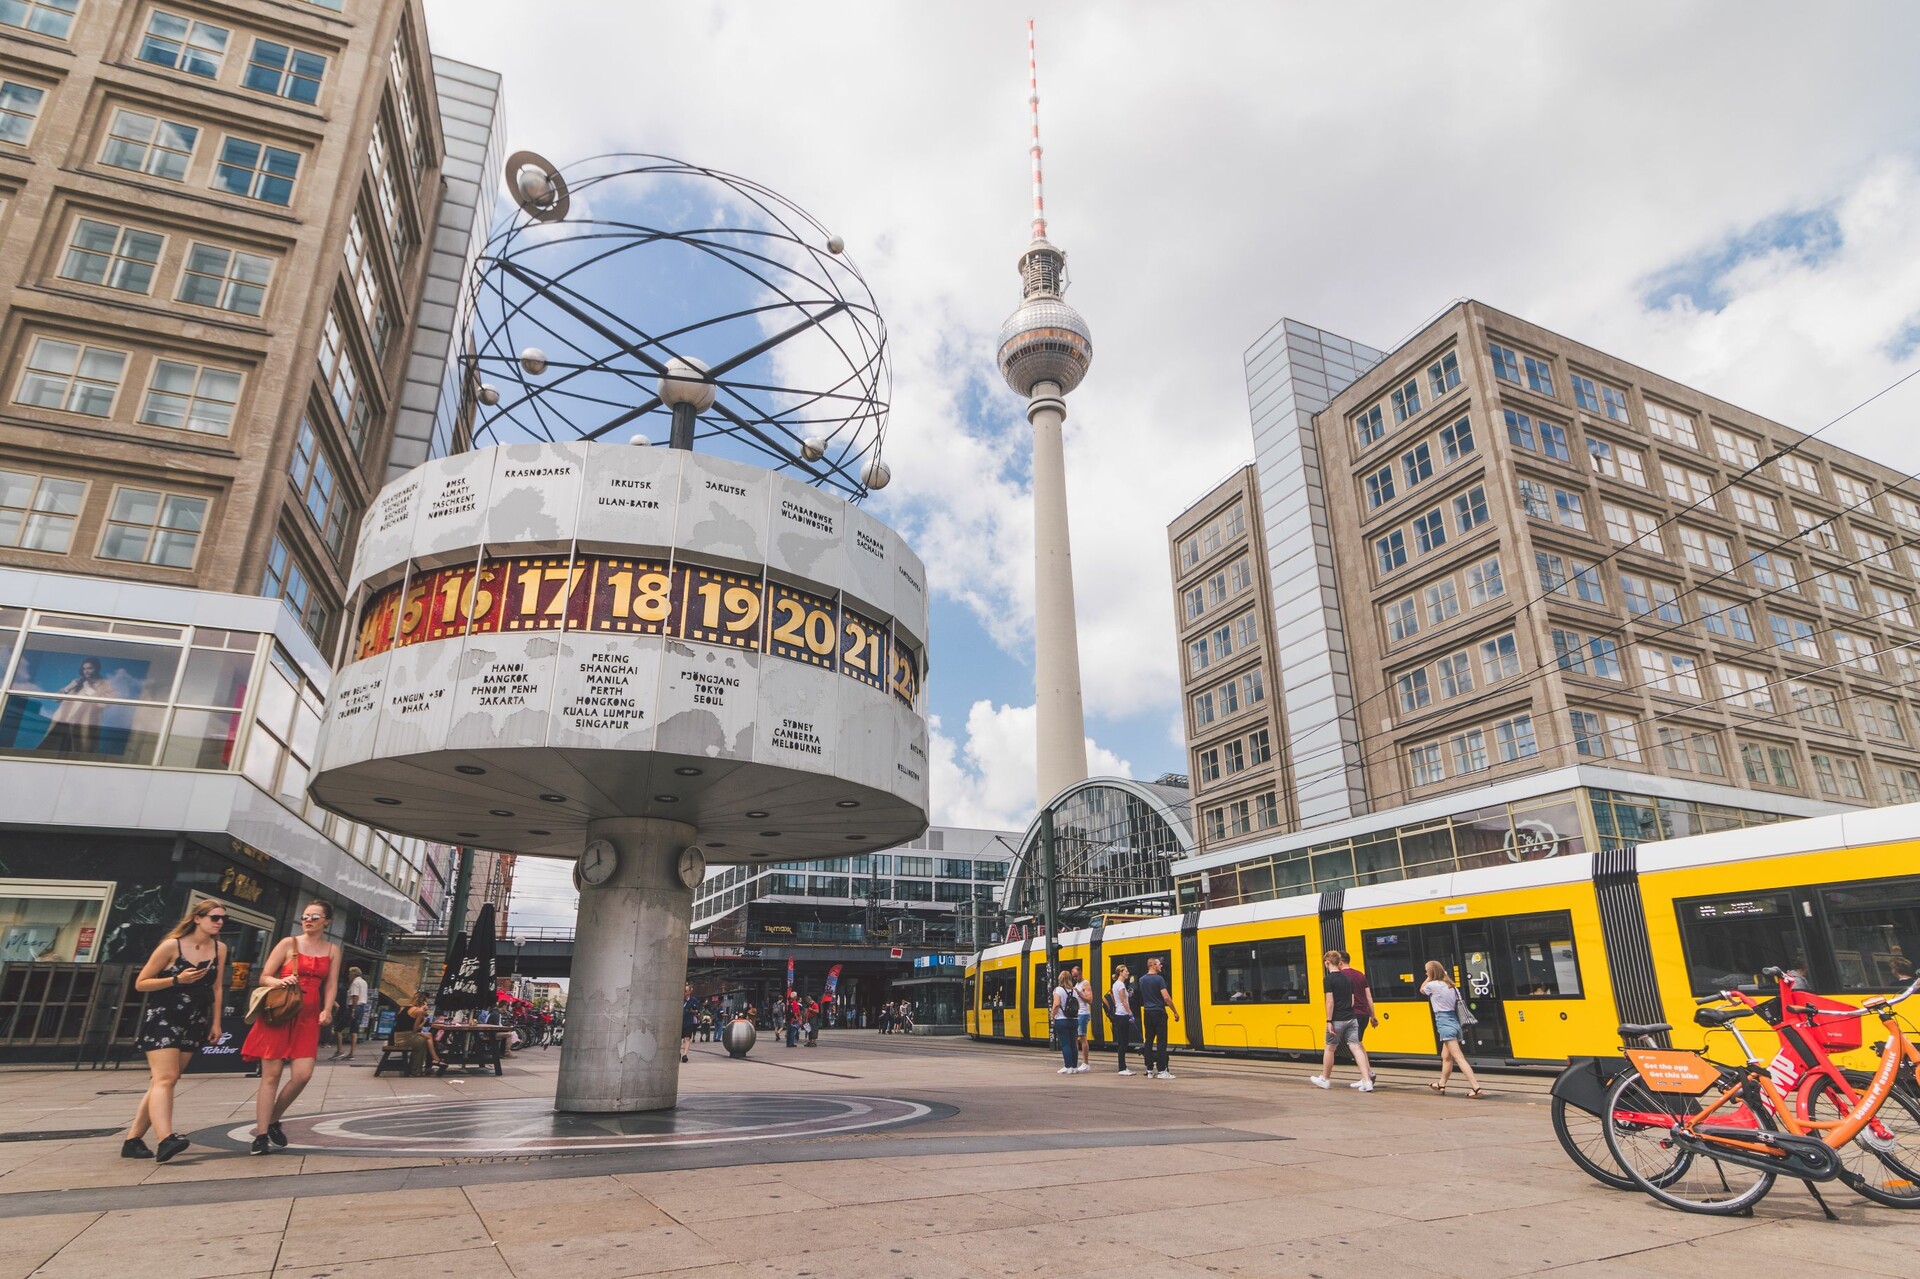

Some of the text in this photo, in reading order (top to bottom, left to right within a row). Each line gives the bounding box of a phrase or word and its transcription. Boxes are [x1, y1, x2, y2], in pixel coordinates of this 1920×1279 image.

[504, 466, 570, 478] KRASNOJARSK
[446, 478, 466, 488] OMSK
[610, 479, 652, 490] IRKUTSK
[706, 480, 746, 497] JAKUTSK
[440, 486, 470, 499] ALMATY
[432, 494, 476, 510] TASCHKENT
[598, 498, 660, 510] ULAN-BATOR
[428, 503, 476, 520] NOWOSIBIRSK
[782, 500, 833, 526] CHABAROWSK
[780, 508, 834, 535] WLADIWOSTOK
[857, 530, 884, 551] MAGADAN
[856, 539, 884, 560] SACHALIN
[441, 571, 496, 624] 16
[518, 567, 587, 616] 17
[608, 569, 673, 623] 18
[388, 585, 427, 640] 15
[697, 581, 761, 632] 19
[773, 598, 837, 656] 20
[843, 622, 880, 677] 21
[591, 653, 630, 664] PEKING
[491, 664, 524, 673] HANOI
[580, 664, 638, 675] SHANGHAI
[887, 647, 912, 701] 22
[482, 674, 529, 684] BANGKOK
[586, 674, 630, 685] MANILA
[680, 671, 740, 688] PJÖNGJANG
[471, 684, 538, 696] PHNOM PENH
[590, 686, 624, 696] PERTH
[695, 685, 724, 696] TOKYO
[392, 692, 425, 706] RANGUN
[479, 696, 526, 706] JAKARTA
[575, 696, 636, 708] HONGKONG
[693, 696, 724, 706] SEOUL
[402, 702, 430, 714] DHAKA
[562, 706, 645, 720] KUALA LUMPUR
[575, 719, 630, 730] SINGAPUR
[782, 719, 814, 732] SYDNEY
[774, 728, 821, 745] CANBERRA
[772, 738, 822, 755] MELBOURNE
[897, 762, 920, 782] WELLINGTON
[938, 955, 946, 965] U
[202, 1045, 238, 1055] Tchibo
[1854, 1052, 1896, 1120] DONKEY REPUBLIC
